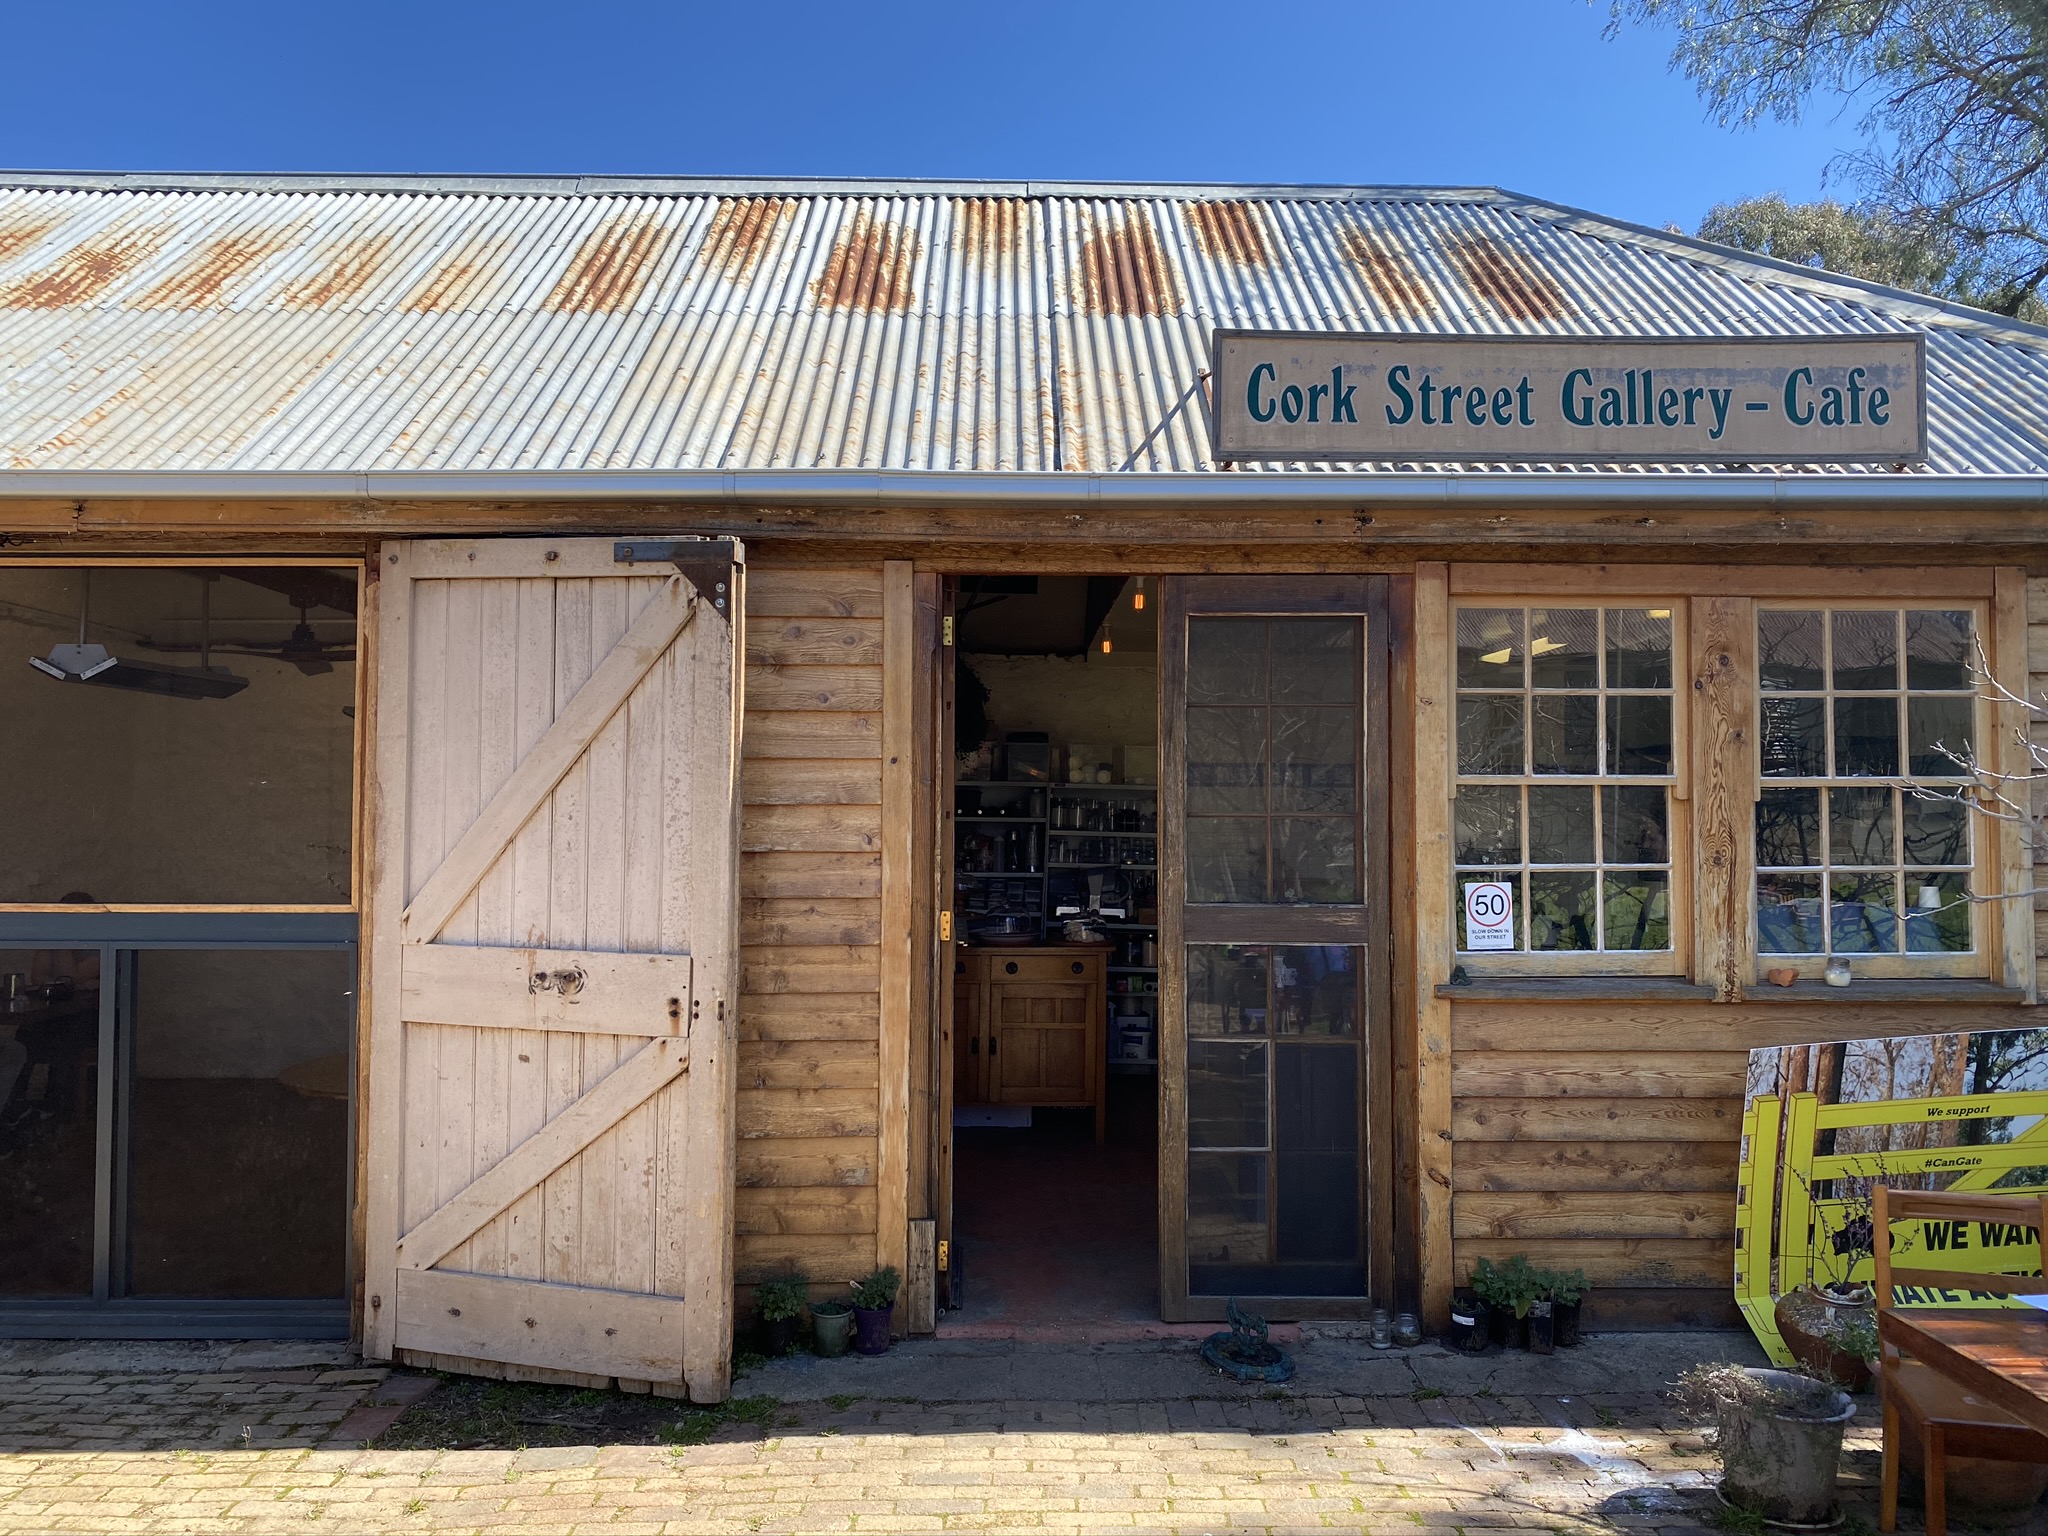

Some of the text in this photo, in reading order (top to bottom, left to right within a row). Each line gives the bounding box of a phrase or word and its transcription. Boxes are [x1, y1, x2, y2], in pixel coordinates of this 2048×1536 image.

[1246, 362, 1359, 424] Cork
[1384, 364, 1537, 427] Street
[1561, 367, 1733, 441] Gallery
[1783, 366, 1891, 427] Cafe
[1475, 894, 1504, 916] 50
[1927, 1105, 1991, 1117] We support
[1924, 1157, 1983, 1168] #CanGate
[1924, 1221, 1969, 1251] WE
